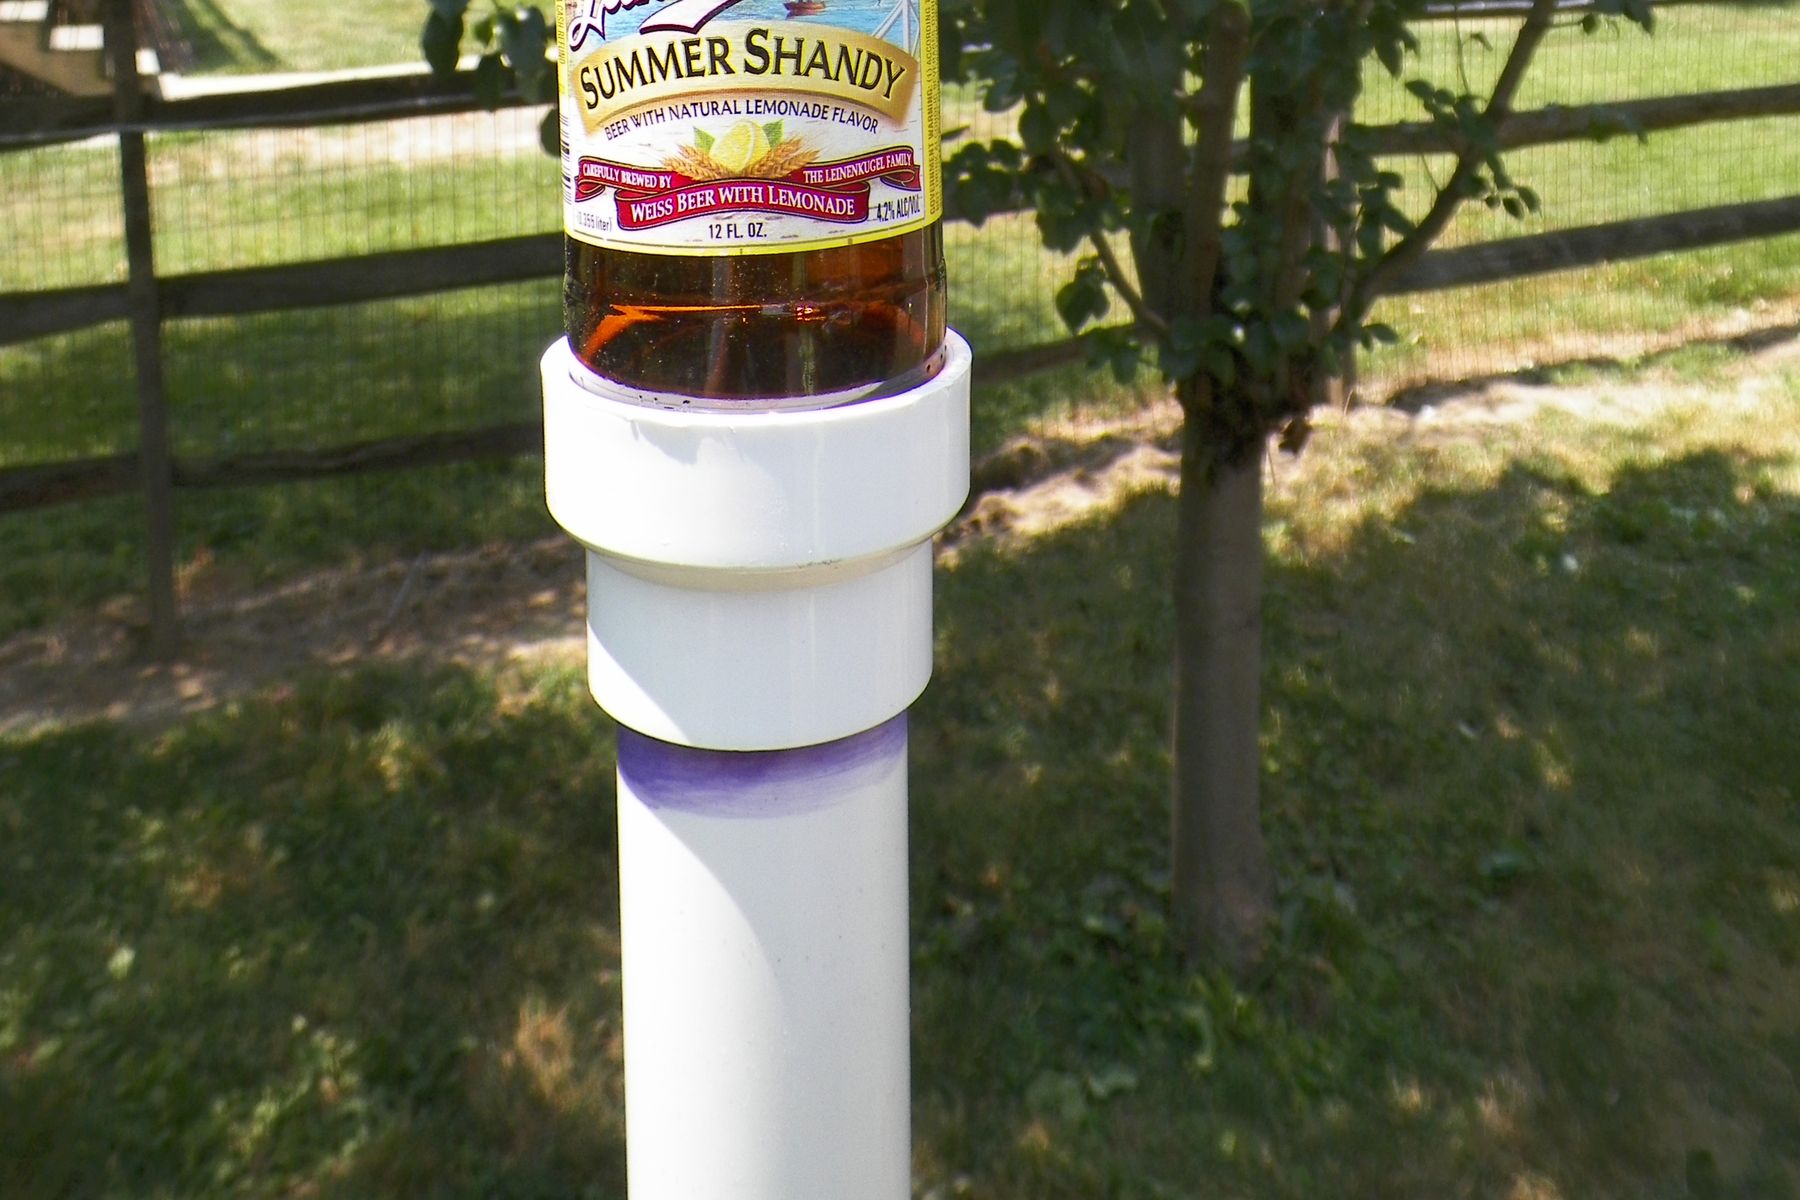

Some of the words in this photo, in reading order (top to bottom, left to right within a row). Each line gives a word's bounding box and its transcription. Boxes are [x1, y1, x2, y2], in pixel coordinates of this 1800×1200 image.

[581, 35, 736, 110] SUMMER
[743, 28, 907, 100] SHANDY
[604, 118, 631, 142] BEER
[630, 109, 666, 129] WITH
[668, 100, 742, 122] NATURAL
[745, 99, 830, 121] LEMONADE
[831, 106, 879, 135] FLAVOR
[621, 170, 658, 189] BREWED
[659, 175, 672, 189] BY
[803, 168, 824, 184] THE
[825, 158, 886, 183] LEINENKUGEL
[886, 152, 912, 168] FAMILY
[630, 197, 674, 223] WEISS
[676, 189, 717, 212] BEER
[718, 186, 764, 205] WITH
[768, 185, 855, 216] LEMONADE
[708, 224, 723, 239] 12
[727, 223, 744, 239] FL.
[747, 222, 767, 238] OZ.
